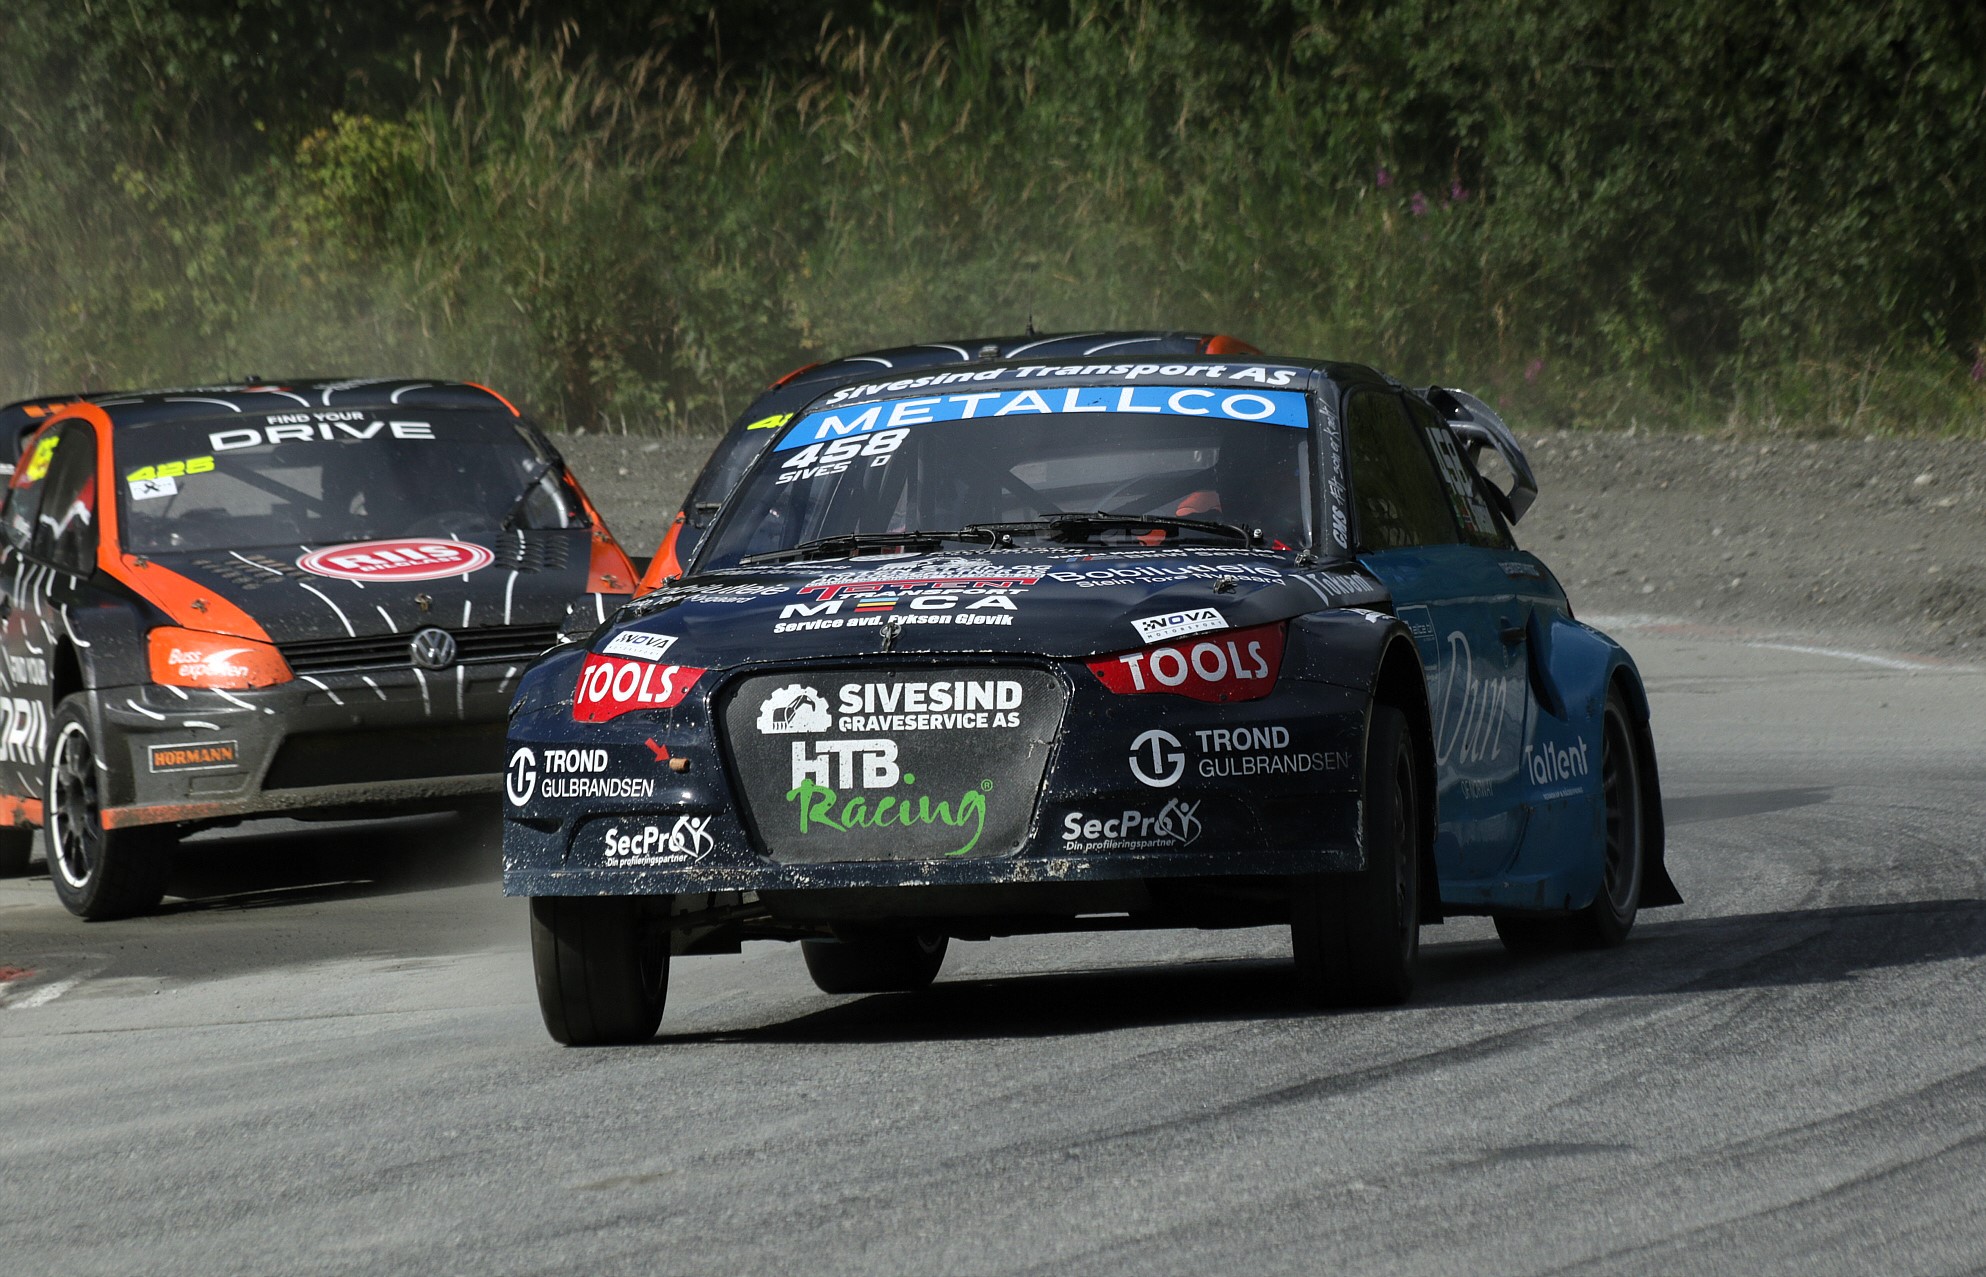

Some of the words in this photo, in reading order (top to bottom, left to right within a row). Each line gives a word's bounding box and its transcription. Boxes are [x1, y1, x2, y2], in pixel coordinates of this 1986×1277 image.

[826, 368, 1007, 405] Sivesind
[1015, 363, 1229, 380] Transport
[1229, 367, 1297, 386] AS
[266, 413, 311, 425] FIND
[313, 411, 364, 423] YOUR
[815, 386, 1276, 439] METALLCO
[208, 421, 436, 451] DRIVE
[782, 428, 911, 469] 458
[775, 460, 852, 485] SIVES
[1332, 504, 1348, 549] GMS
[327, 545, 460, 569] RIIS
[1194, 551, 1286, 560] Service
[1048, 563, 1282, 583] Bobilutleie
[1076, 579, 1134, 588] Stein
[1137, 574, 1188, 584] Tore
[838, 588, 1029, 600] TRANSPORT
[773, 620, 843, 634] Service
[846, 616, 884, 627] avd.
[1147, 621, 1222, 639] MOTORSPORT
[1149, 610, 1217, 630] NOVA
[625, 634, 669, 648] NOVA
[1119, 641, 1269, 691] TOOLS
[577, 662, 680, 705] TOOLS
[838, 680, 1023, 714] SIVESIND
[838, 715, 988, 733] GRAVESERVICE
[991, 711, 1021, 728] AS
[1196, 726, 1290, 753] TROND
[544, 749, 609, 773] TROND
[791, 738, 900, 790] HTB
[1199, 751, 1349, 778] GULBRANDSEN
[541, 778, 654, 798] GULBRANDSEN
[786, 773, 987, 856] Racing
[1062, 810, 1173, 841] SecPro
[604, 826, 685, 857] SecPro
[1063, 841, 1083, 851] -Din
[1086, 838, 1176, 852] profileringspartner
